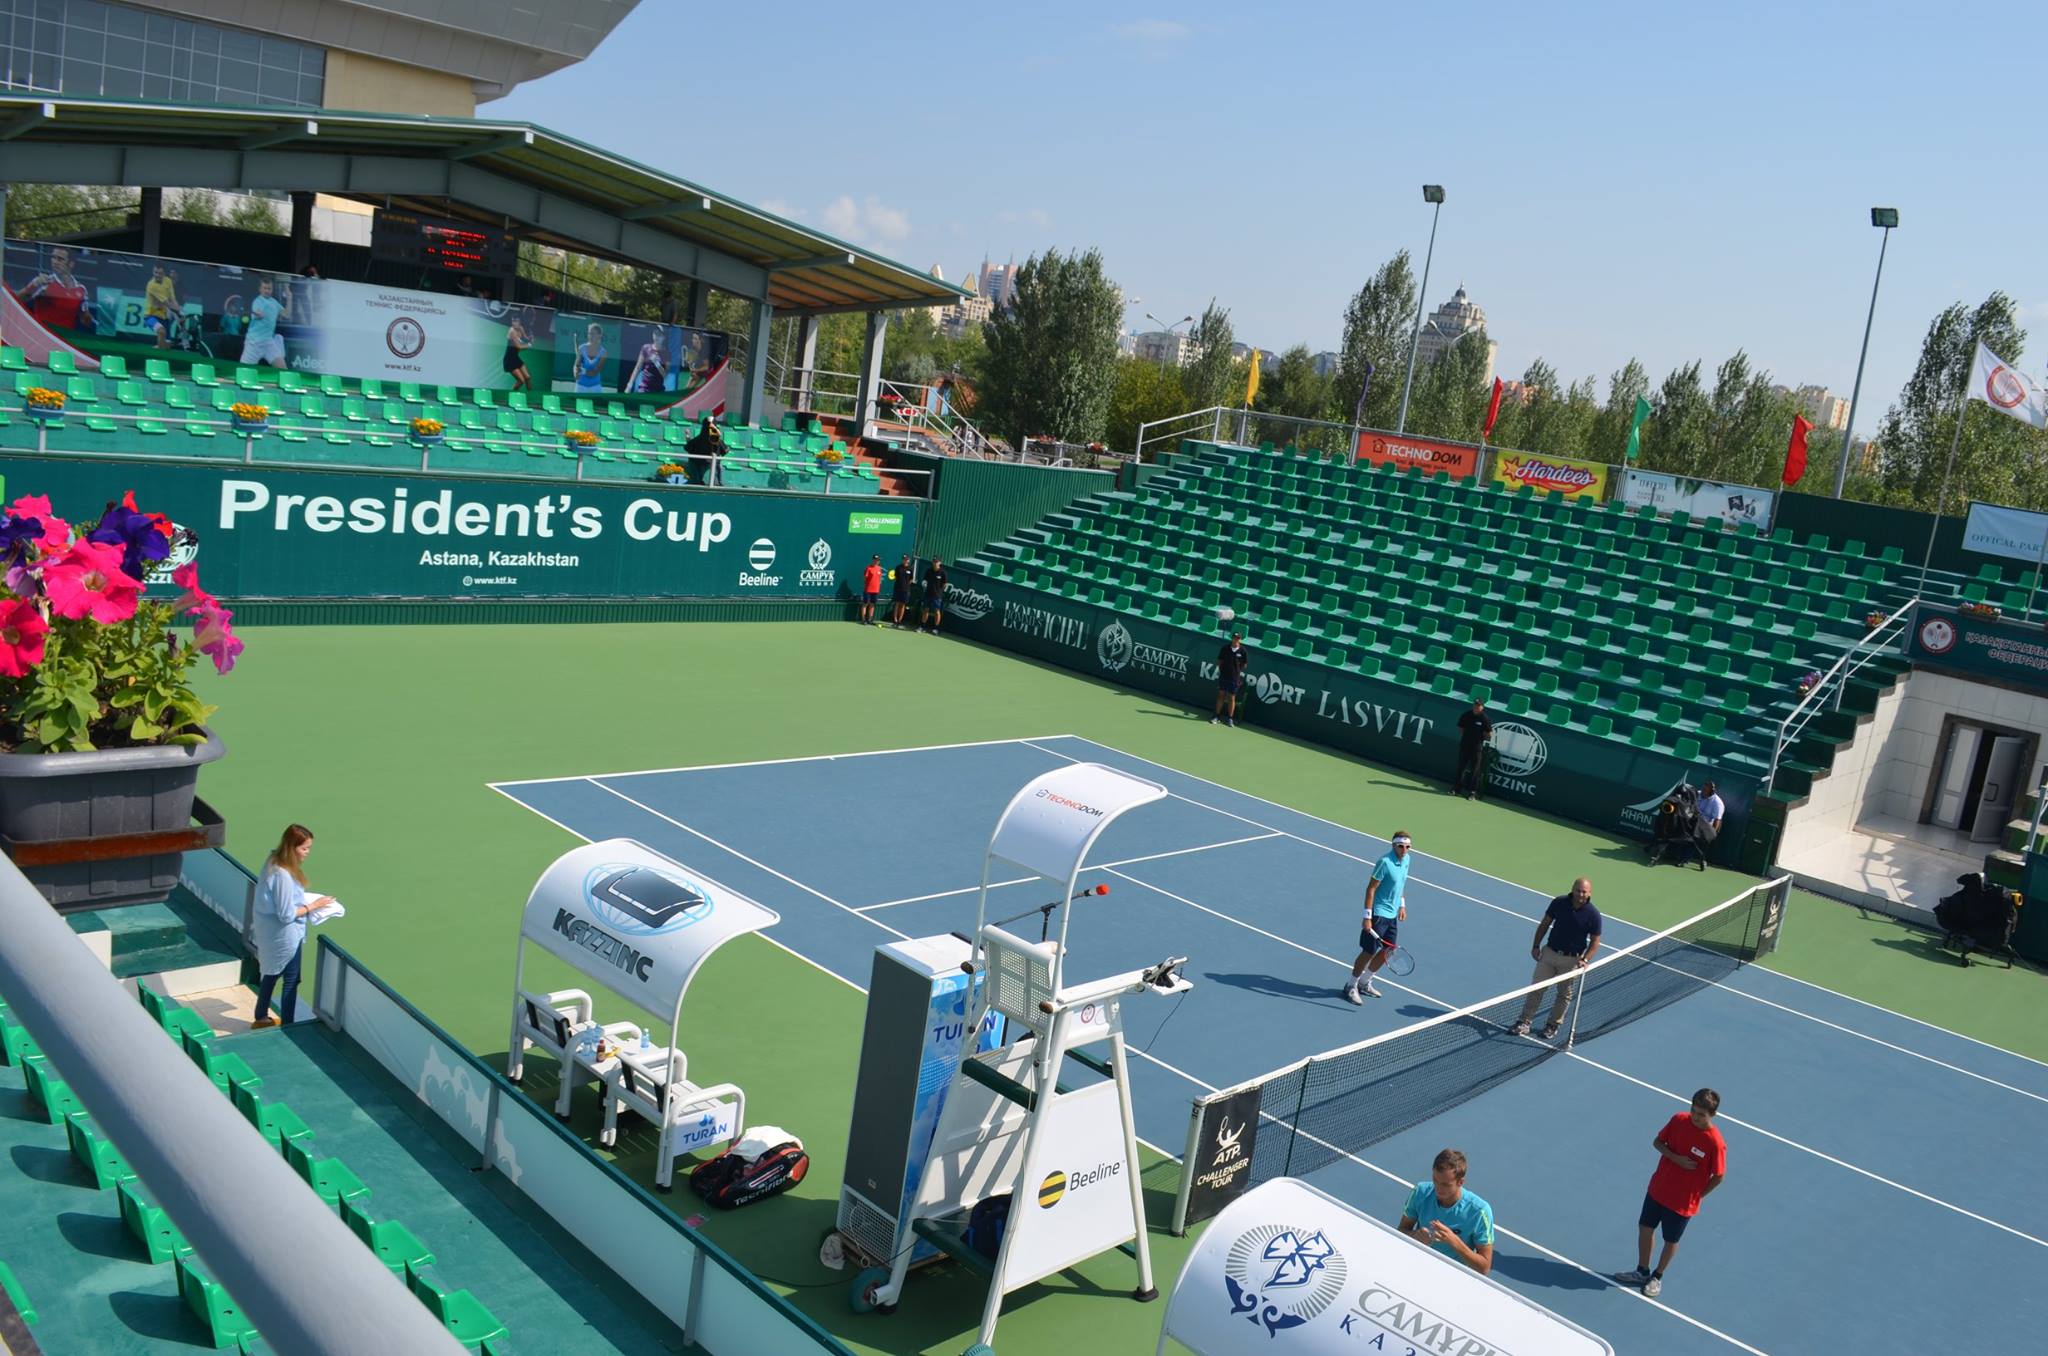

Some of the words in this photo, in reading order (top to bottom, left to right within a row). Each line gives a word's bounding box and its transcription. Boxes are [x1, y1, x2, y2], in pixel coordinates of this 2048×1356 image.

[1386, 443, 1463, 466] TECHNODOM
[1515, 459, 1597, 486] Hardee's
[219, 479, 603, 540] President's
[623, 498, 732, 553] Cup
[419, 550, 483, 569] Astana,
[488, 550, 579, 567] Kazakhstan
[474, 575, 518, 585] www.ktf.kz
[739, 571, 780, 587] Beeline
[1133, 645, 1189, 672] САМРУК
[1316, 690, 1434, 745] LASVIT
[1487, 772, 1537, 796] ZZINC
[1046, 792, 1104, 817] TECHNODOM
[1621, 807, 1653, 825] KHAN
[552, 907, 654, 983] KAZZINC
[933, 1014, 997, 1044] TUN
[683, 1122, 728, 1145] TURAN
[1212, 1145, 1241, 1167] ATP
[1069, 1161, 1121, 1192] Beeline
[1196, 1157, 1249, 1187] CHALLENGER
[1211, 1174, 1234, 1190] TOUR
